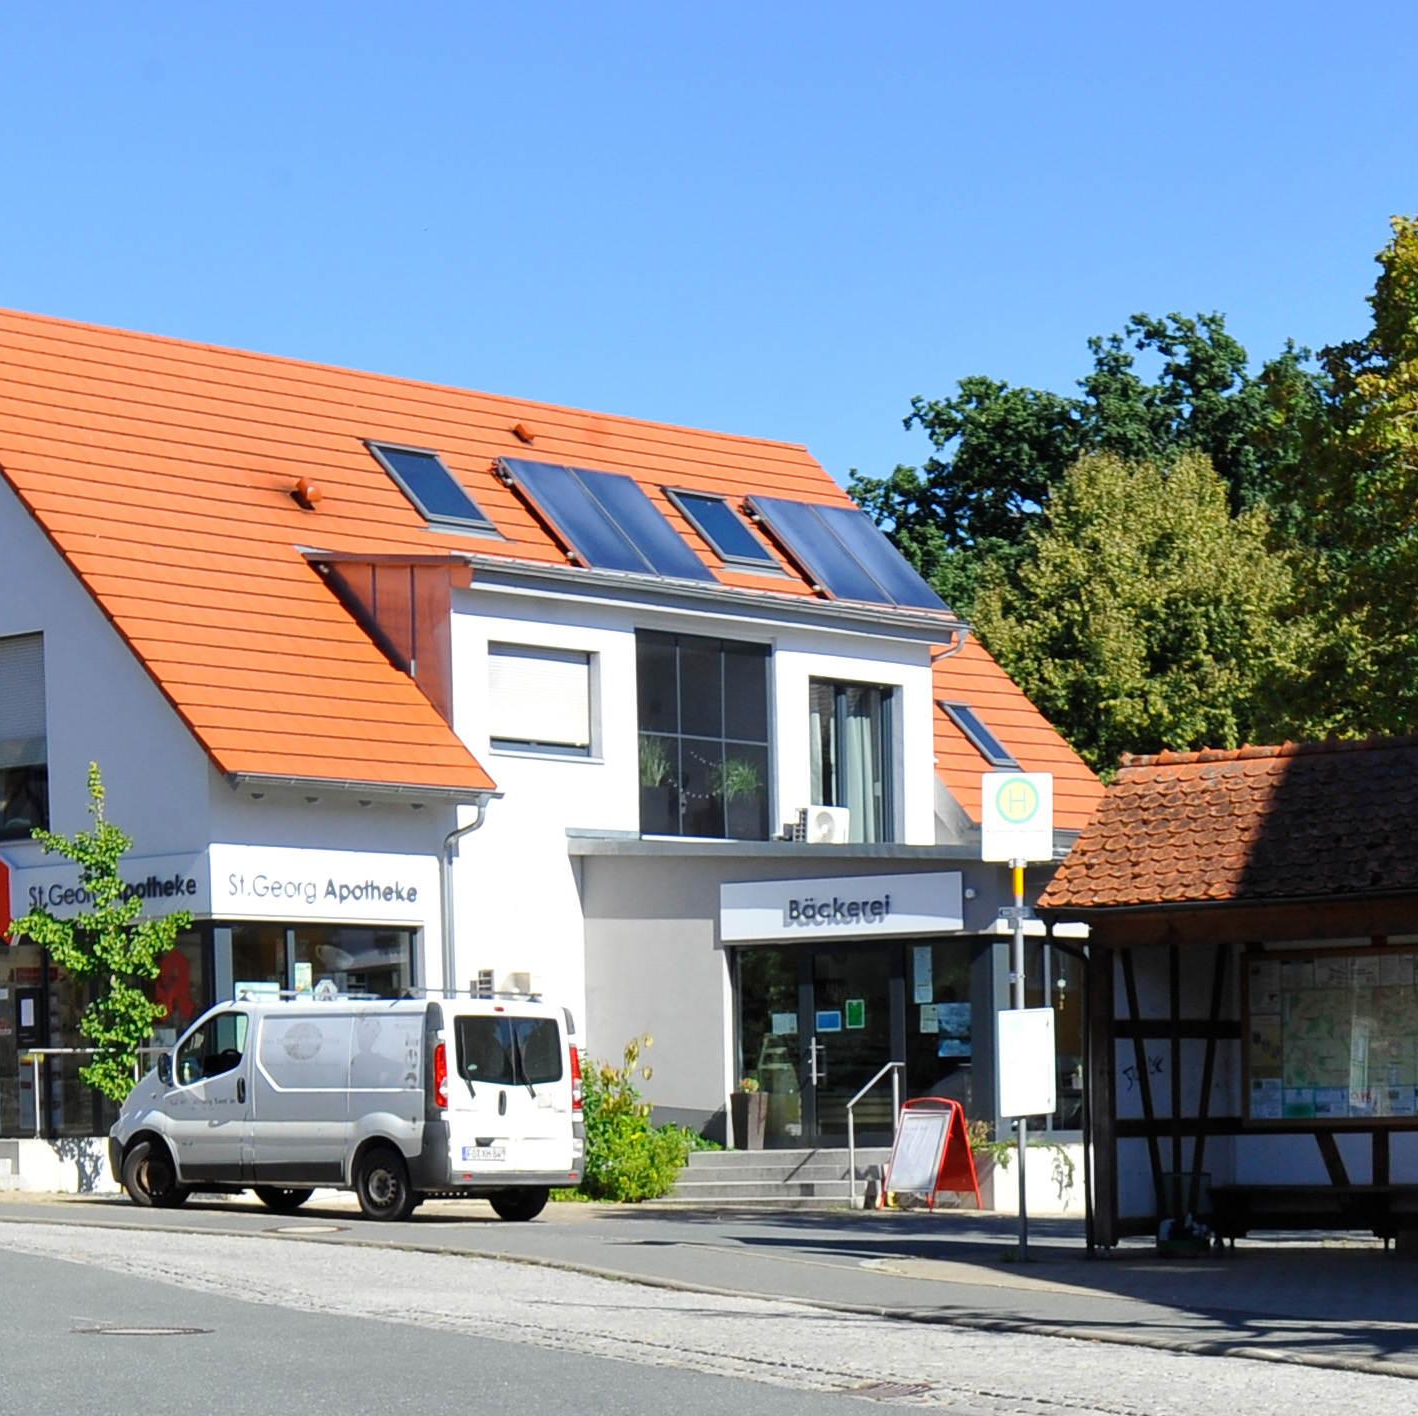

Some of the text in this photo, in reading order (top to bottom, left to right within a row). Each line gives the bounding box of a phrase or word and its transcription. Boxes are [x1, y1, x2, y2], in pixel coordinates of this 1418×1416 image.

[28, 874, 197, 909] St.Geor potheke
[229, 873, 418, 904] St.Georg Apotheke
[789, 894, 891, 920] Bäckerei
